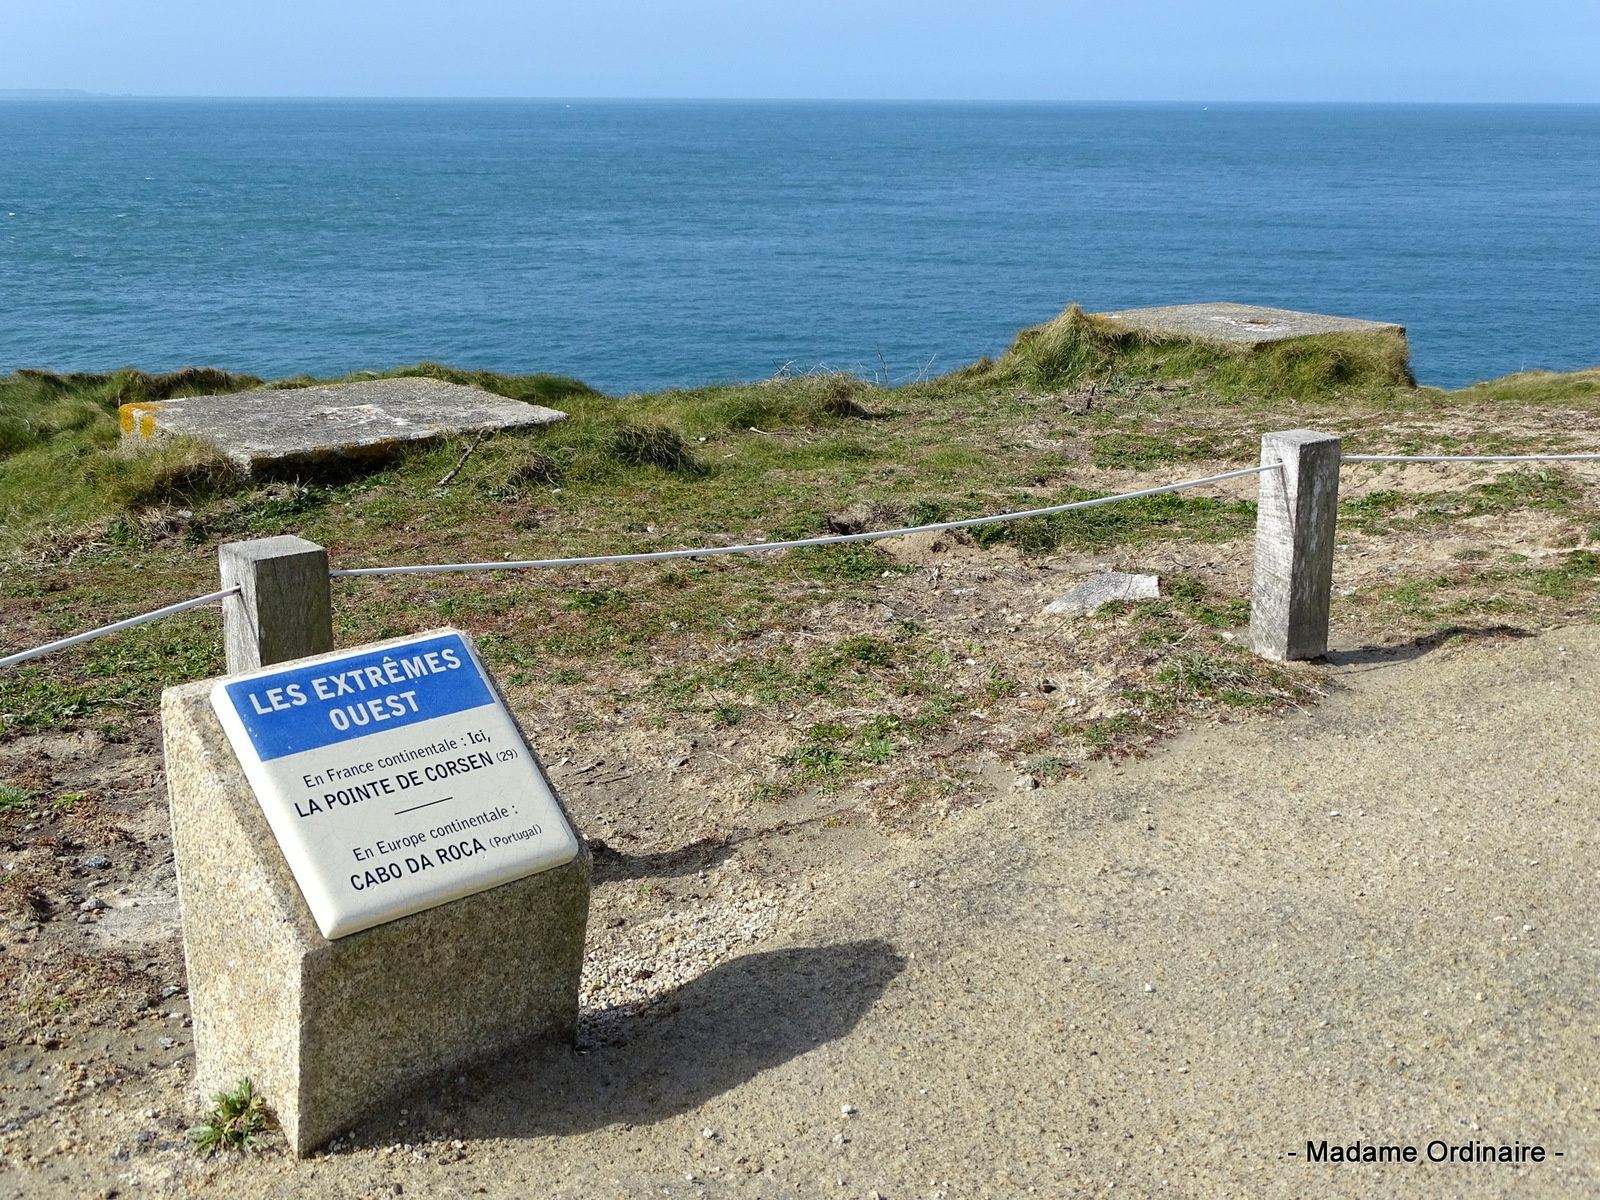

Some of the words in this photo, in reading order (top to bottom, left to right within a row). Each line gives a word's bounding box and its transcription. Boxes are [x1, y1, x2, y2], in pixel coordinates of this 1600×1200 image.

[249, 683, 308, 715] LES
[311, 648, 461, 700] EXTRÊMES
[329, 690, 417, 731] OUEST
[294, 798, 323, 818] LA
[324, 777, 395, 810] POINTE
[399, 770, 424, 790] DE
[424, 751, 494, 783] CORSEN
[496, 748, 518, 764] (29)
[303, 773, 325, 788] En
[327, 761, 374, 781] France
[377, 737, 458, 769] continentale
[467, 729, 492, 745] Ici,
[350, 863, 403, 892] CABO
[405, 855, 435, 875] DA
[436, 837, 487, 865] ROCA
[488, 823, 543, 850] (Portugal)
[352, 847, 374, 862] En
[376, 833, 427, 857] Europe
[430, 807, 509, 840] continentale
